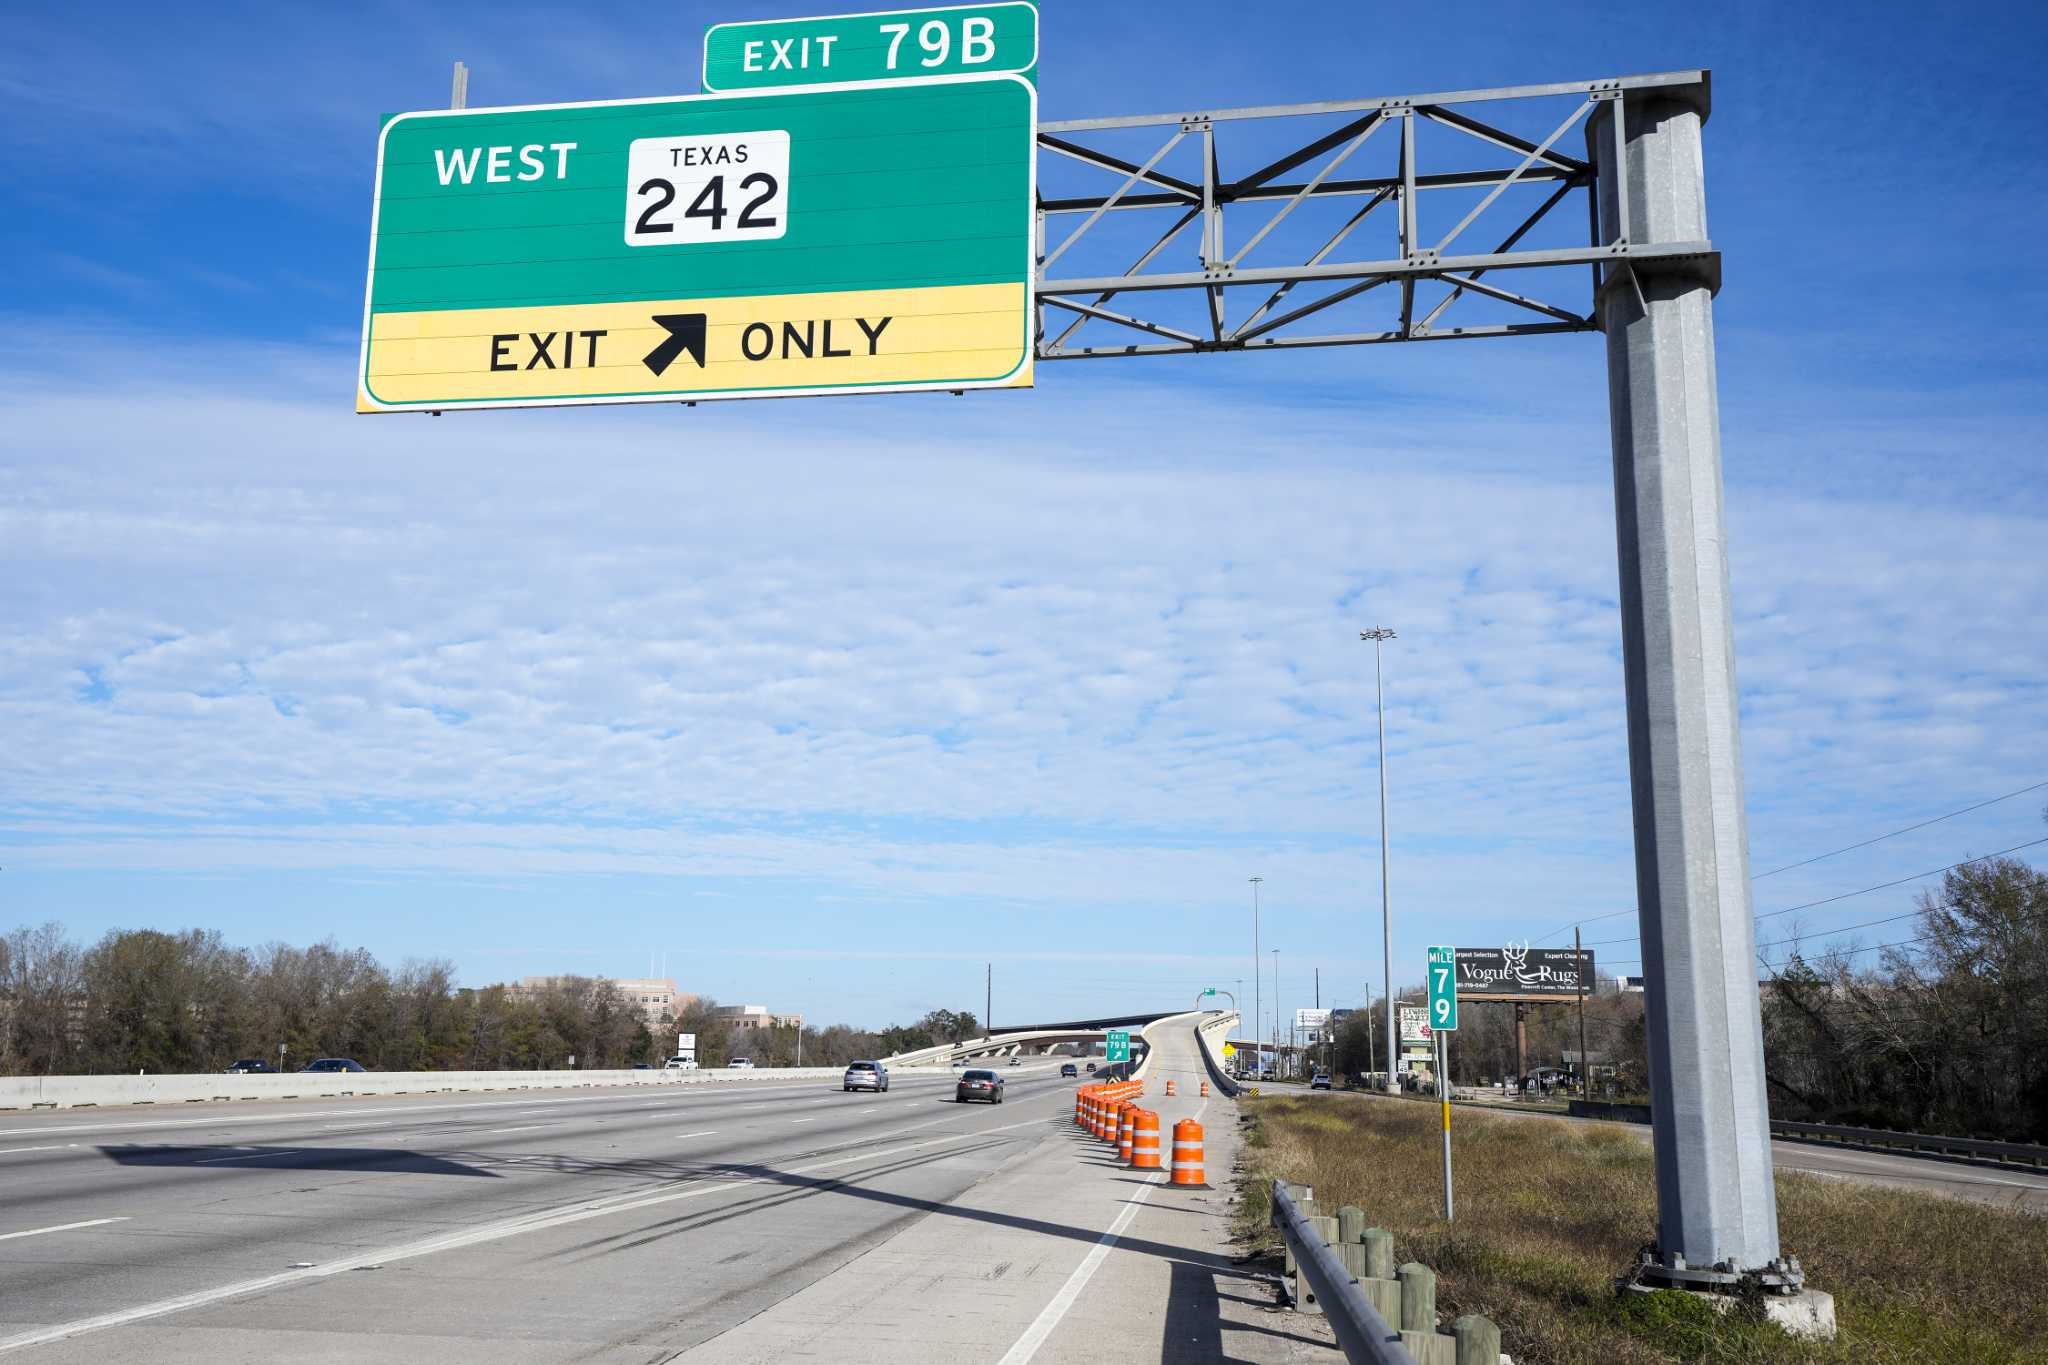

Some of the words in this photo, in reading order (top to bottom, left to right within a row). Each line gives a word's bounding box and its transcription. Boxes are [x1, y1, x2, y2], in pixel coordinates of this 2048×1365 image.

[743, 35, 838, 72] EXIT
[879, 16, 996, 70] 79B
[434, 142, 577, 186] WEST
[670, 144, 749, 167] TEXAS
[634, 172, 779, 234] 242
[490, 329, 608, 372] EXIT
[741, 316, 893, 361] ONLY
[1429, 952, 1453, 963] MILE
[1455, 951, 1472, 959] argest
[1461, 963, 1513, 983] Vogue
[1539, 965, 1579, 985] Rugs
